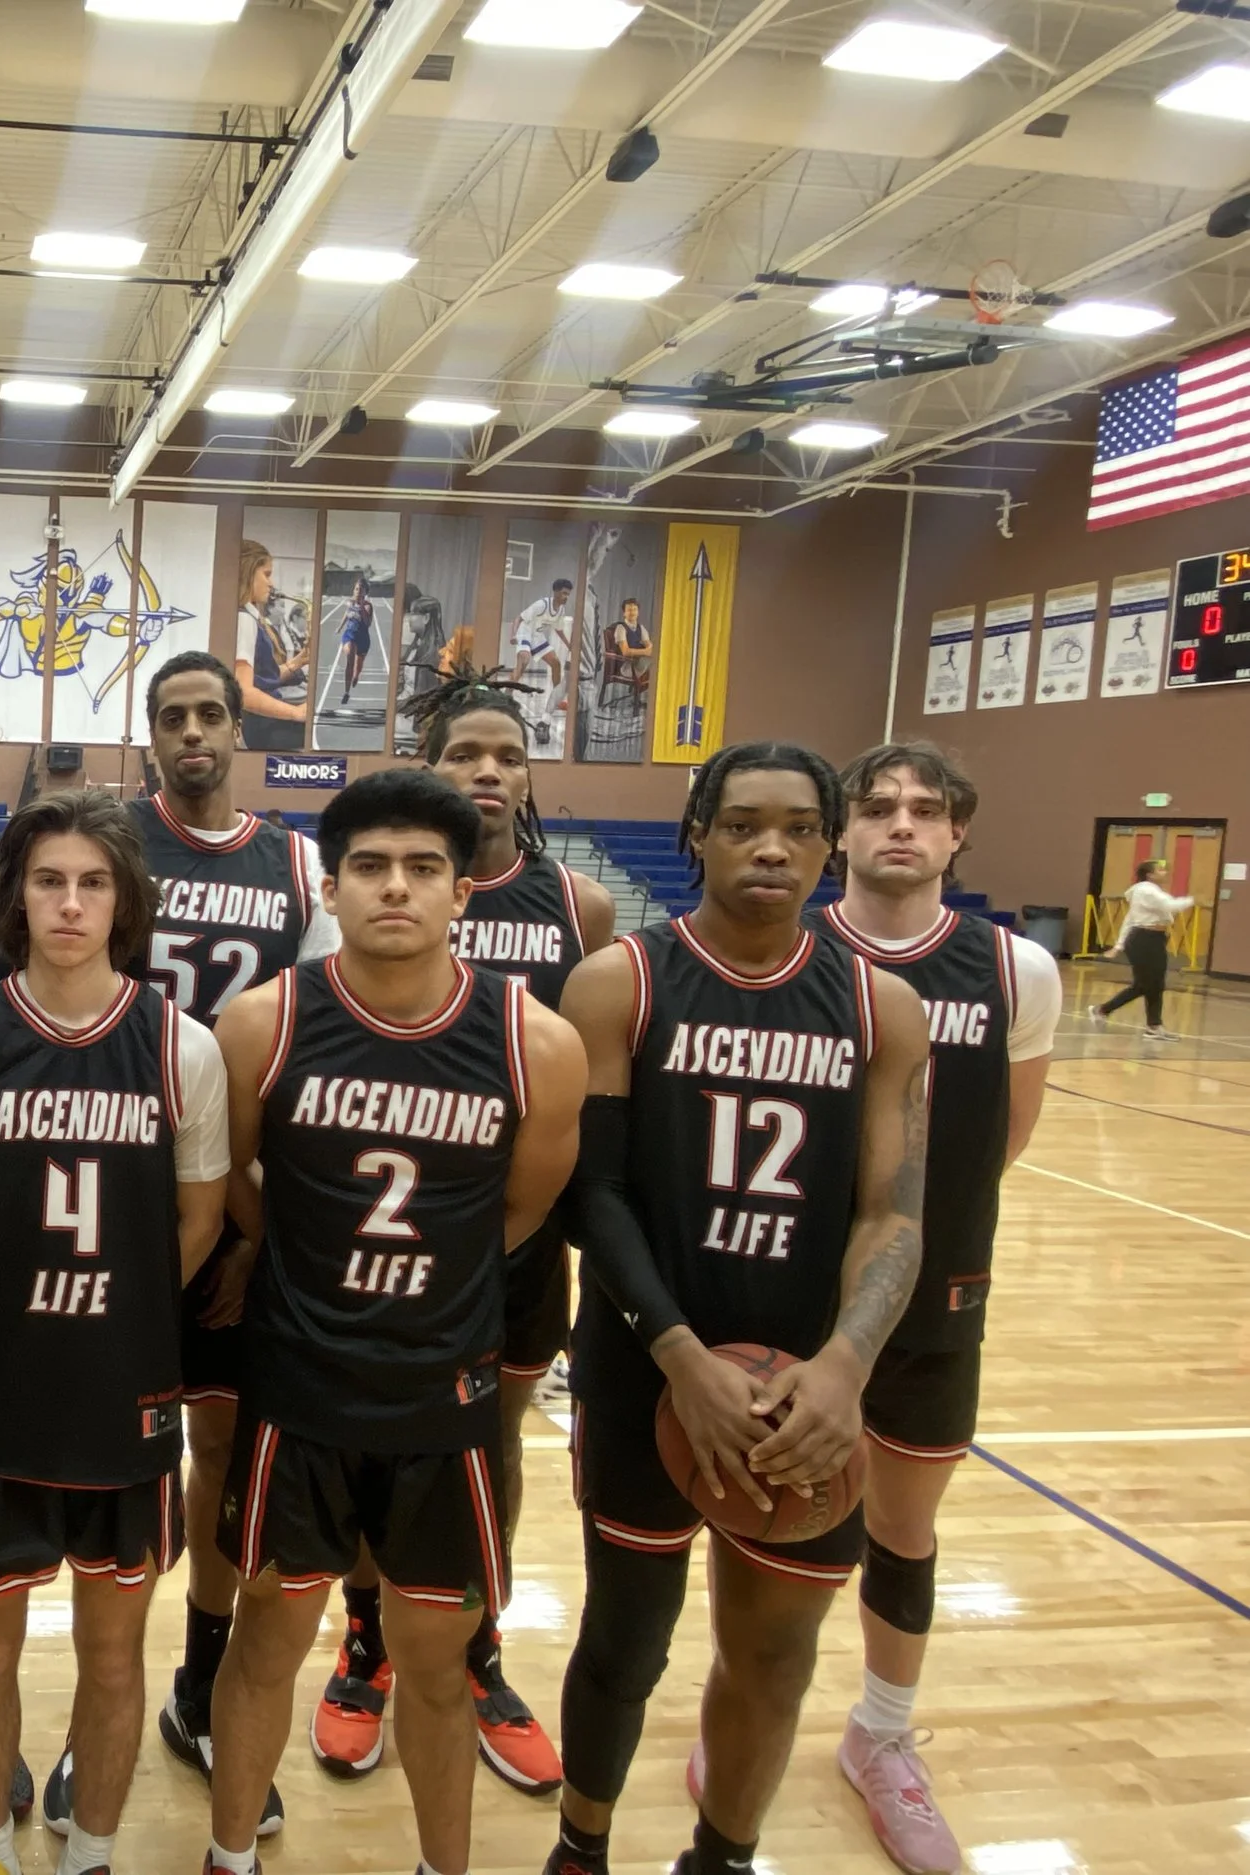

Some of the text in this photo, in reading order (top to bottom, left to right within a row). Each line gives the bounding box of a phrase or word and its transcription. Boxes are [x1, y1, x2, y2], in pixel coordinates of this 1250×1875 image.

[1184, 590, 1219, 607] HOME
[1203, 605, 1223, 635] 0
[1181, 648, 1196, 671] 0
[273, 763, 339, 780] JUNIORS
[447, 920, 561, 963] CENDING
[148, 929, 262, 1018] 52
[660, 1022, 857, 1090] ASCENDING
[290, 1074, 507, 1148] ASCENDING
[700, 1089, 807, 1200] 12
[41, 1156, 101, 1257] 4
[353, 1148, 422, 1240] 2
[699, 1207, 798, 1260] LIFE
[25, 1268, 113, 1316] LIFE
[338, 1249, 436, 1298] LIFE
